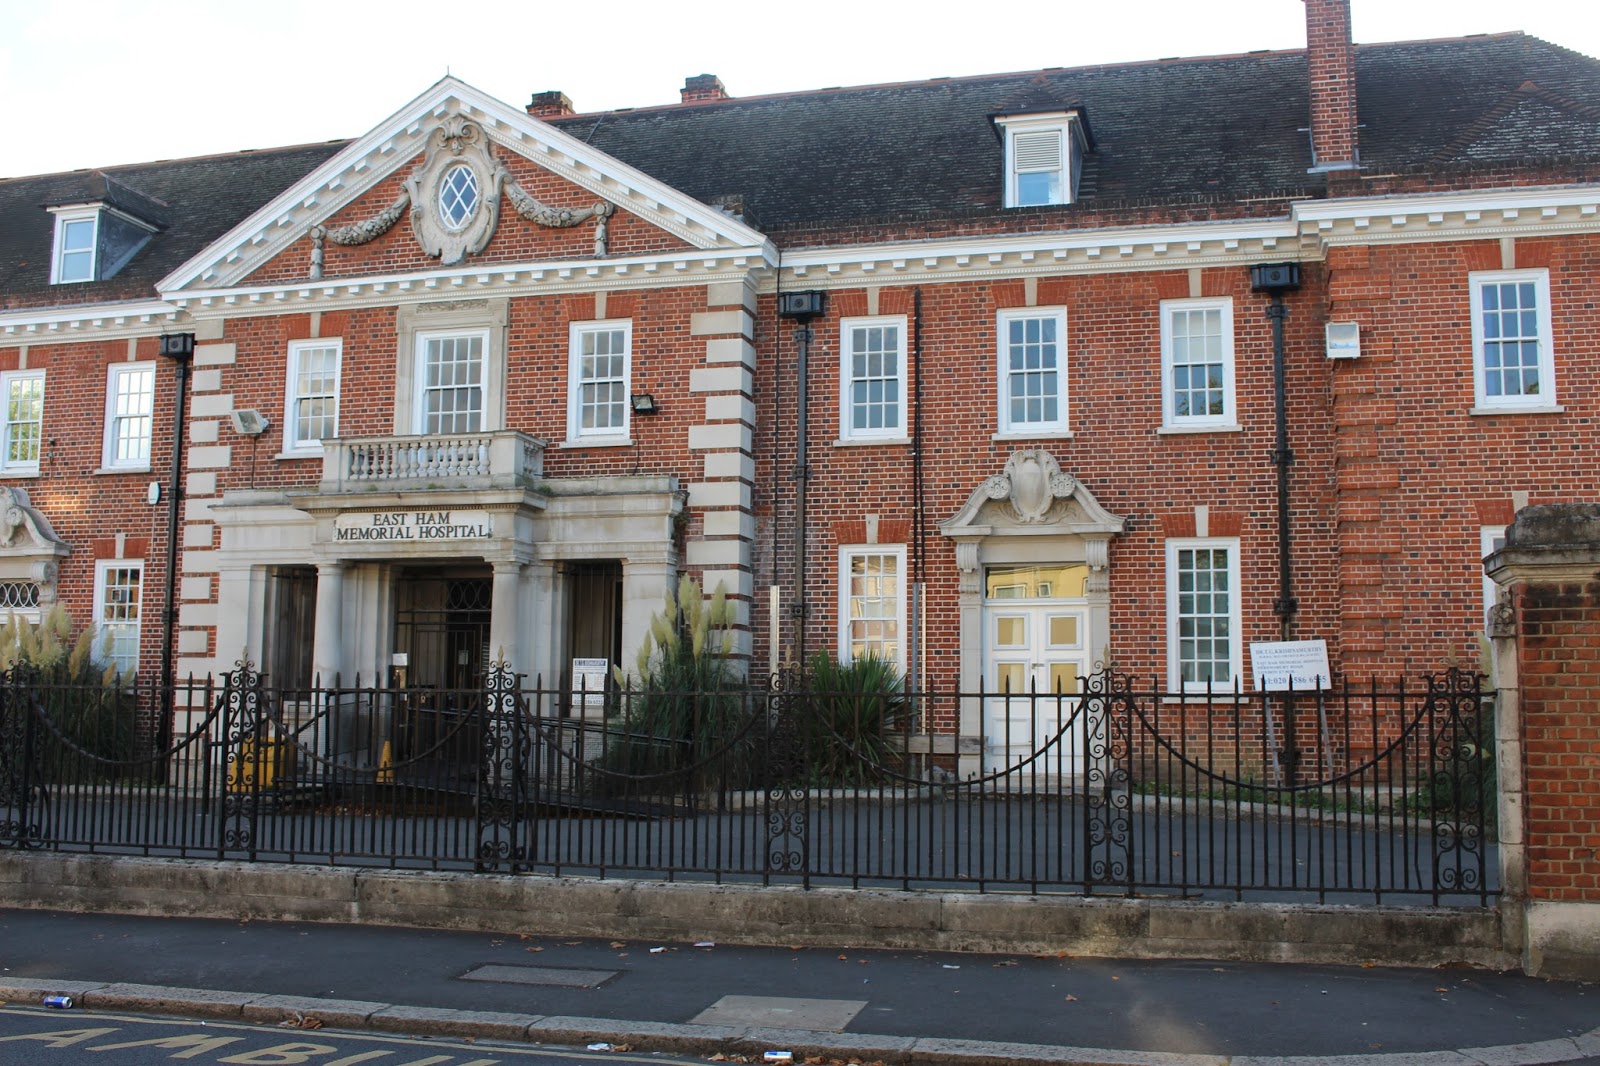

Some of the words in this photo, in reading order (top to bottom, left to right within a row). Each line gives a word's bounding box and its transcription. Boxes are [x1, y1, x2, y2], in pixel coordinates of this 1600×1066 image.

[373, 513, 408, 526] EAST
[415, 512, 451, 525] HAM
[336, 526, 414, 540] MEMORIAL
[419, 525, 487, 539] HOSPITAL
